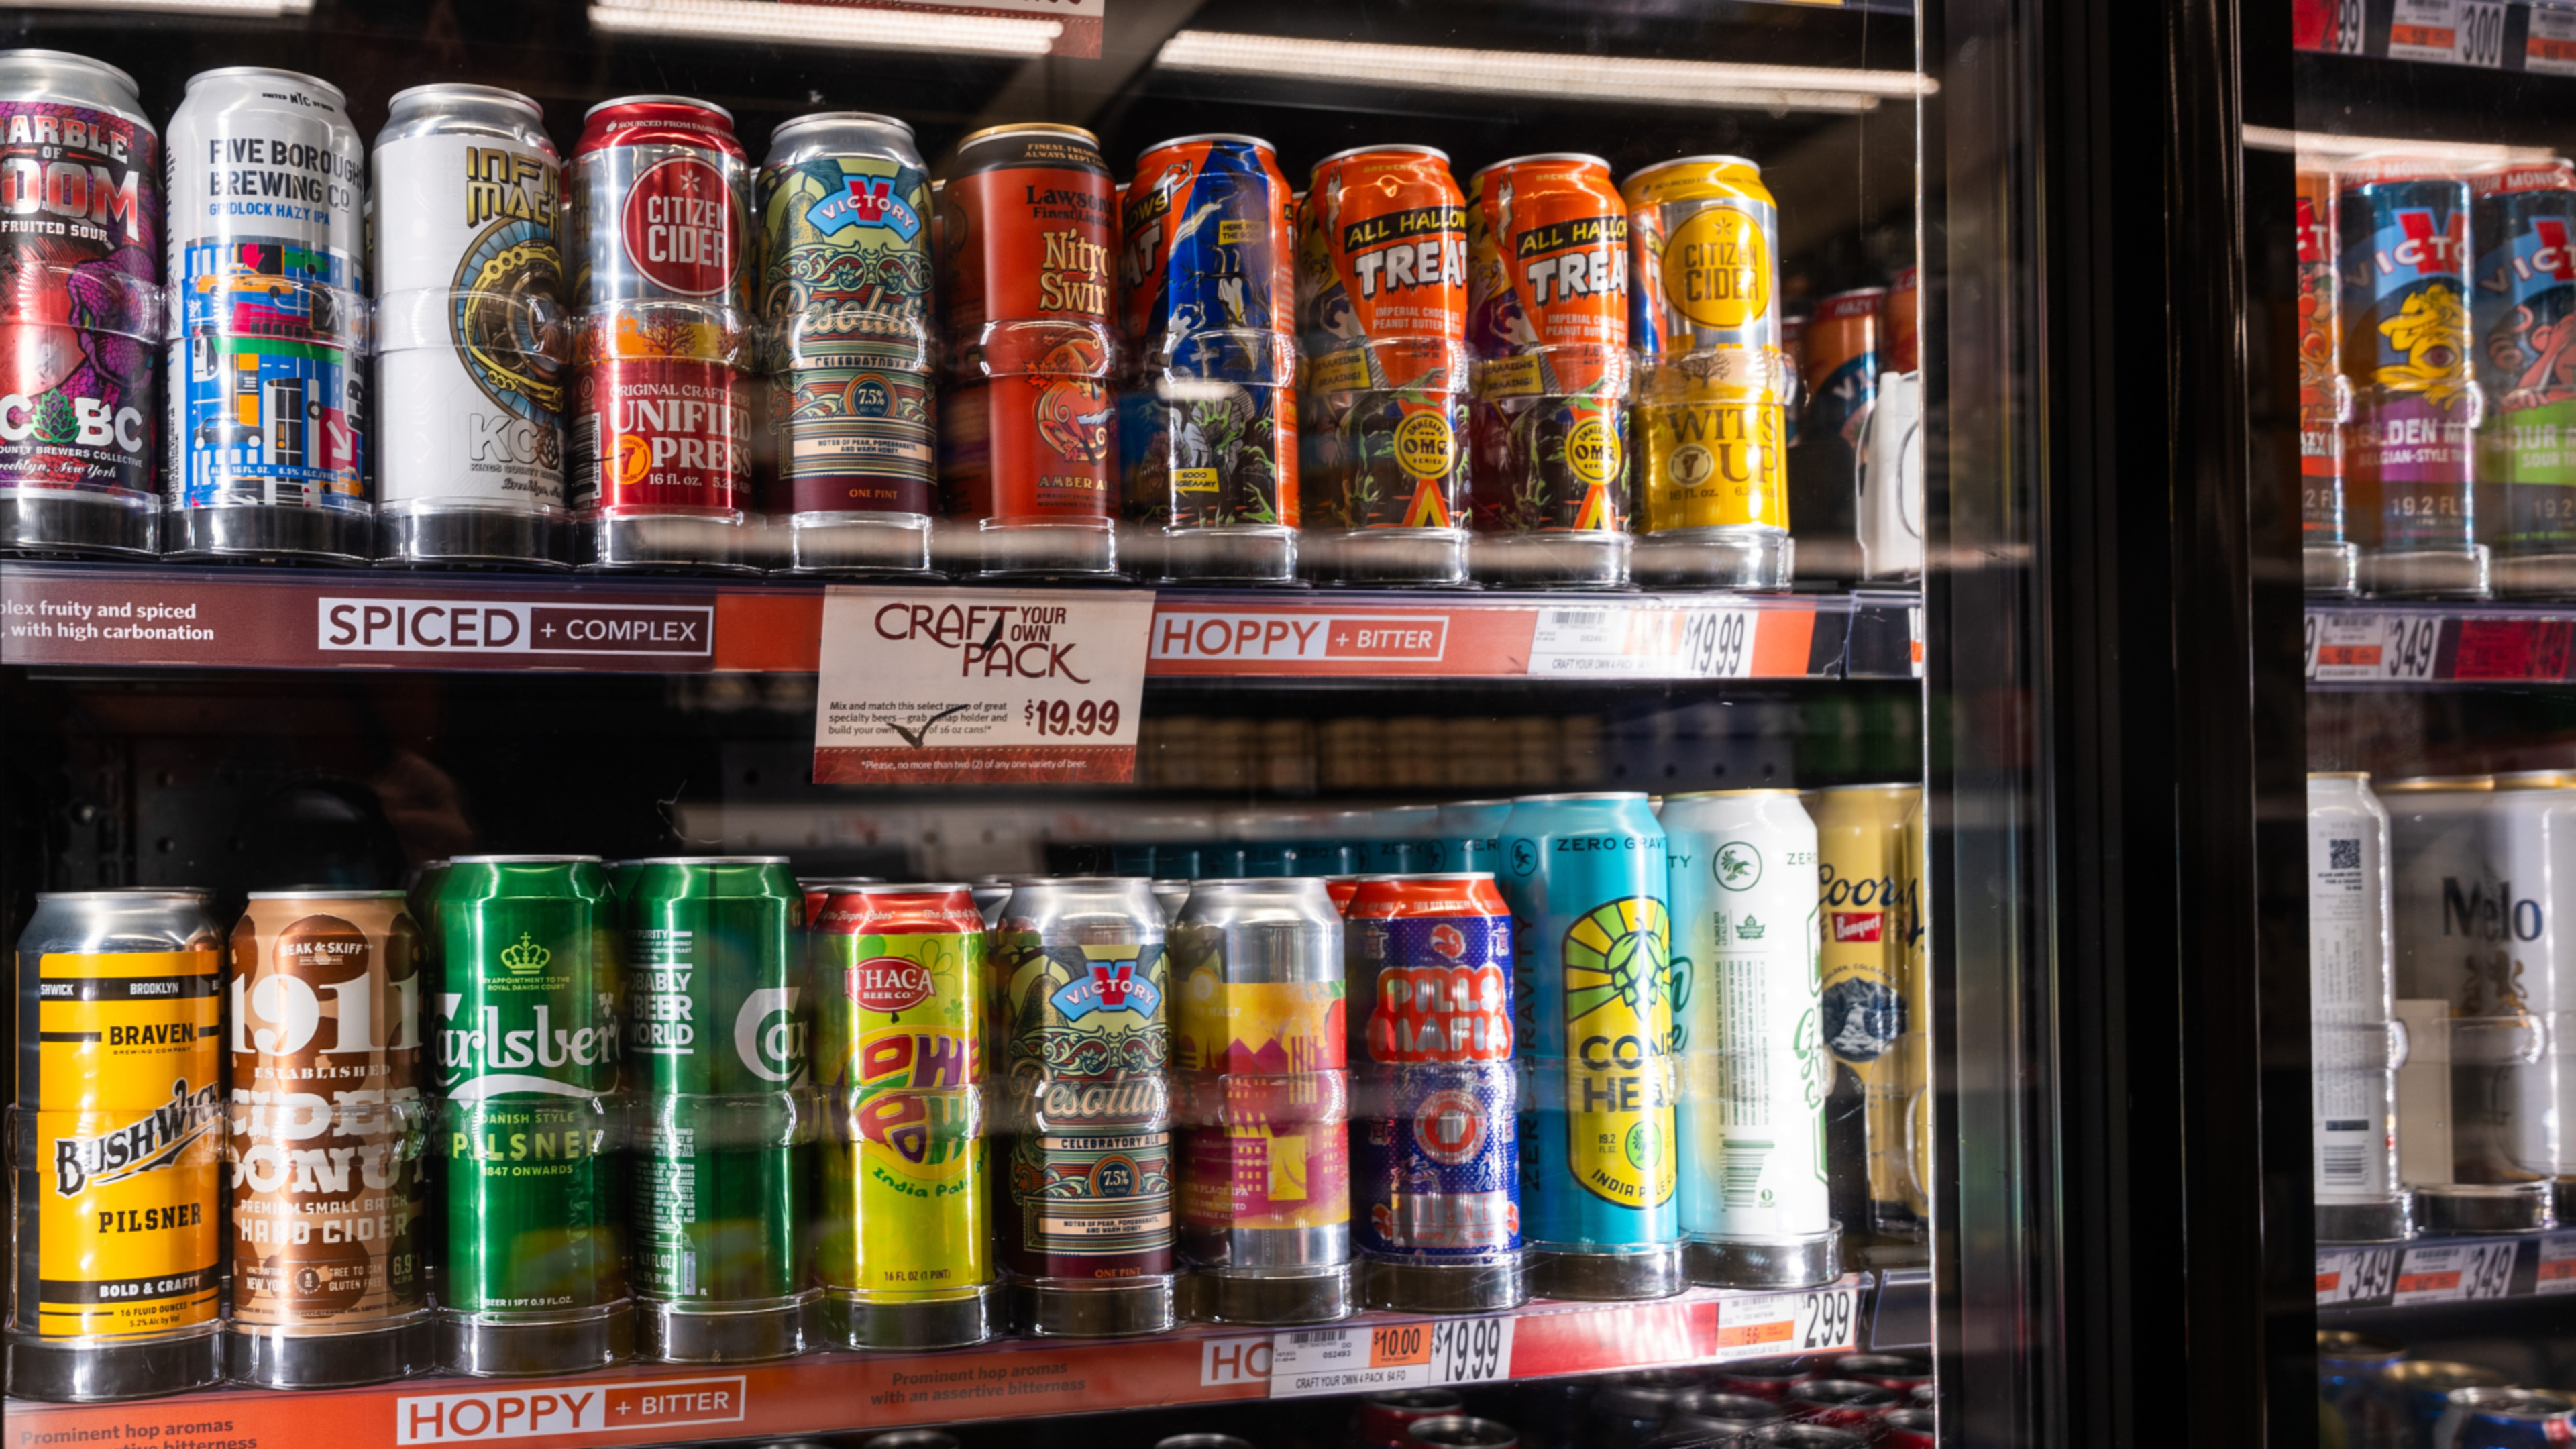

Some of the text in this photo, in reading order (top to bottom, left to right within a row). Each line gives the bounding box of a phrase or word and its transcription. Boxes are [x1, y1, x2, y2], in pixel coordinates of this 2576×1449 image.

[42, 146, 62, 159] OF
[209, 138, 264, 164] FIVE
[209, 170, 323, 203] BREWING
[276, 205, 329, 225] HAZY IPA
[648, 195, 725, 228] CITIZEN
[820, 194, 914, 230] VICTORY
[1033, 207, 1076, 221] Finest
[1, 220, 108, 241] FRUITED SOUR
[1348, 220, 1390, 248] ALL
[648, 225, 727, 267] CIDER
[1521, 229, 1566, 255] ALL
[1684, 244, 1758, 268] CITIZEN
[1684, 268, 1760, 302] CIDER
[1376, 306, 1419, 317] IMPERIAL
[1548, 314, 1590, 325] IMPERIAL
[1373, 319, 1443, 329] PEANUT BUTTER
[1546, 326, 1581, 336] PEANUT
[609, 384, 726, 400] ORIGINAL CRAFT
[609, 399, 751, 442] UNIFIED
[36, 447, 143, 467] BREWERS COLLECTIVE
[651, 437, 752, 478] PRESS
[1718, 443, 1778, 484] UP
[87, 463, 117, 479] York
[649, 474, 664, 485] 16
[1038, 475, 1093, 490] AMBER
[849, 490, 898, 500] ONE PINT
[1669, 489, 1681, 500] 16
[1700, 489, 1719, 498] oz.
[2391, 498, 2434, 515] 19.2
[40, 600, 196, 623] fruity and spiced
[1020, 606, 1067, 625] YOUR
[11, 623, 214, 642] with high carbonation
[329, 604, 698, 647] SPICED COMPLEX
[874, 603, 1017, 649] CRAFT
[1010, 625, 1051, 643] OWN
[1161, 619, 1434, 656] HOPPY BITTER
[962, 642, 1091, 685] PACK
[830, 701, 1007, 714] Mix and match this select of great
[1024, 699, 1120, 736] $19.99
[829, 713, 1008, 724] specialty holder and
[828, 725, 855, 735] build
[857, 727, 874, 737] your
[928, 725, 938, 734] of
[898, 759, 1067, 771] no more than two (2) of any one variety of
[1556, 837, 1616, 851] ZERO
[1835, 914, 1882, 940] Banquet
[280, 943, 313, 957] BEAK
[129, 982, 179, 995] BROOKLYN
[843, 968, 936, 996] ITHACA
[1065, 979, 1156, 1005] VICTORY
[1392, 976, 1500, 1013] PILLS
[1375, 1017, 1510, 1052] MAFIA
[155, 1046, 191, 1055] COMPANY
[254, 1064, 392, 1080] ESTABLISHED
[535, 1113, 574, 1124] STYLE
[1061, 1135, 1159, 1149] CELEBRATORY ALE
[1599, 1134, 1616, 1144] 19.2
[512, 1164, 574, 1177] ONWARDS
[873, 1166, 928, 1197] India
[1231, 1187, 1249, 1196] IPA
[1591, 1169, 1635, 1197] INDIA
[241, 1195, 407, 1215] PREMIUM SMALL BATCH
[98, 1202, 202, 1234] PILSNER
[241, 1213, 407, 1245] HARD CIDER
[329, 1265, 364, 1277] TREE TO
[884, 1271, 919, 1281] 16 FL OZ
[1095, 1267, 1140, 1278] ONE PINT
[99, 1275, 201, 1298] BOLD & CRAFTY
[246, 1277, 263, 1290] NEW
[329, 1279, 360, 1292] GLUTEN
[364, 1277, 382, 1287] FREE
[133, 1301, 188, 1316] FLUID OUNCES
[1373, 1328, 1421, 1356] $10.00
[1435, 1318, 1502, 1383] $19.99
[892, 1362, 1068, 1386] Prominent hop aromas
[1296, 1373, 1384, 1389] CRAFT YOUR OWN 4 PACK
[871, 1377, 1086, 1406] with an assertive bitterness
[409, 1391, 729, 1440] HOPPY BITTER
[20, 1425, 121, 1446] Prominent
[125, 1422, 160, 1443] hop
[164, 1418, 234, 1436] aromas
